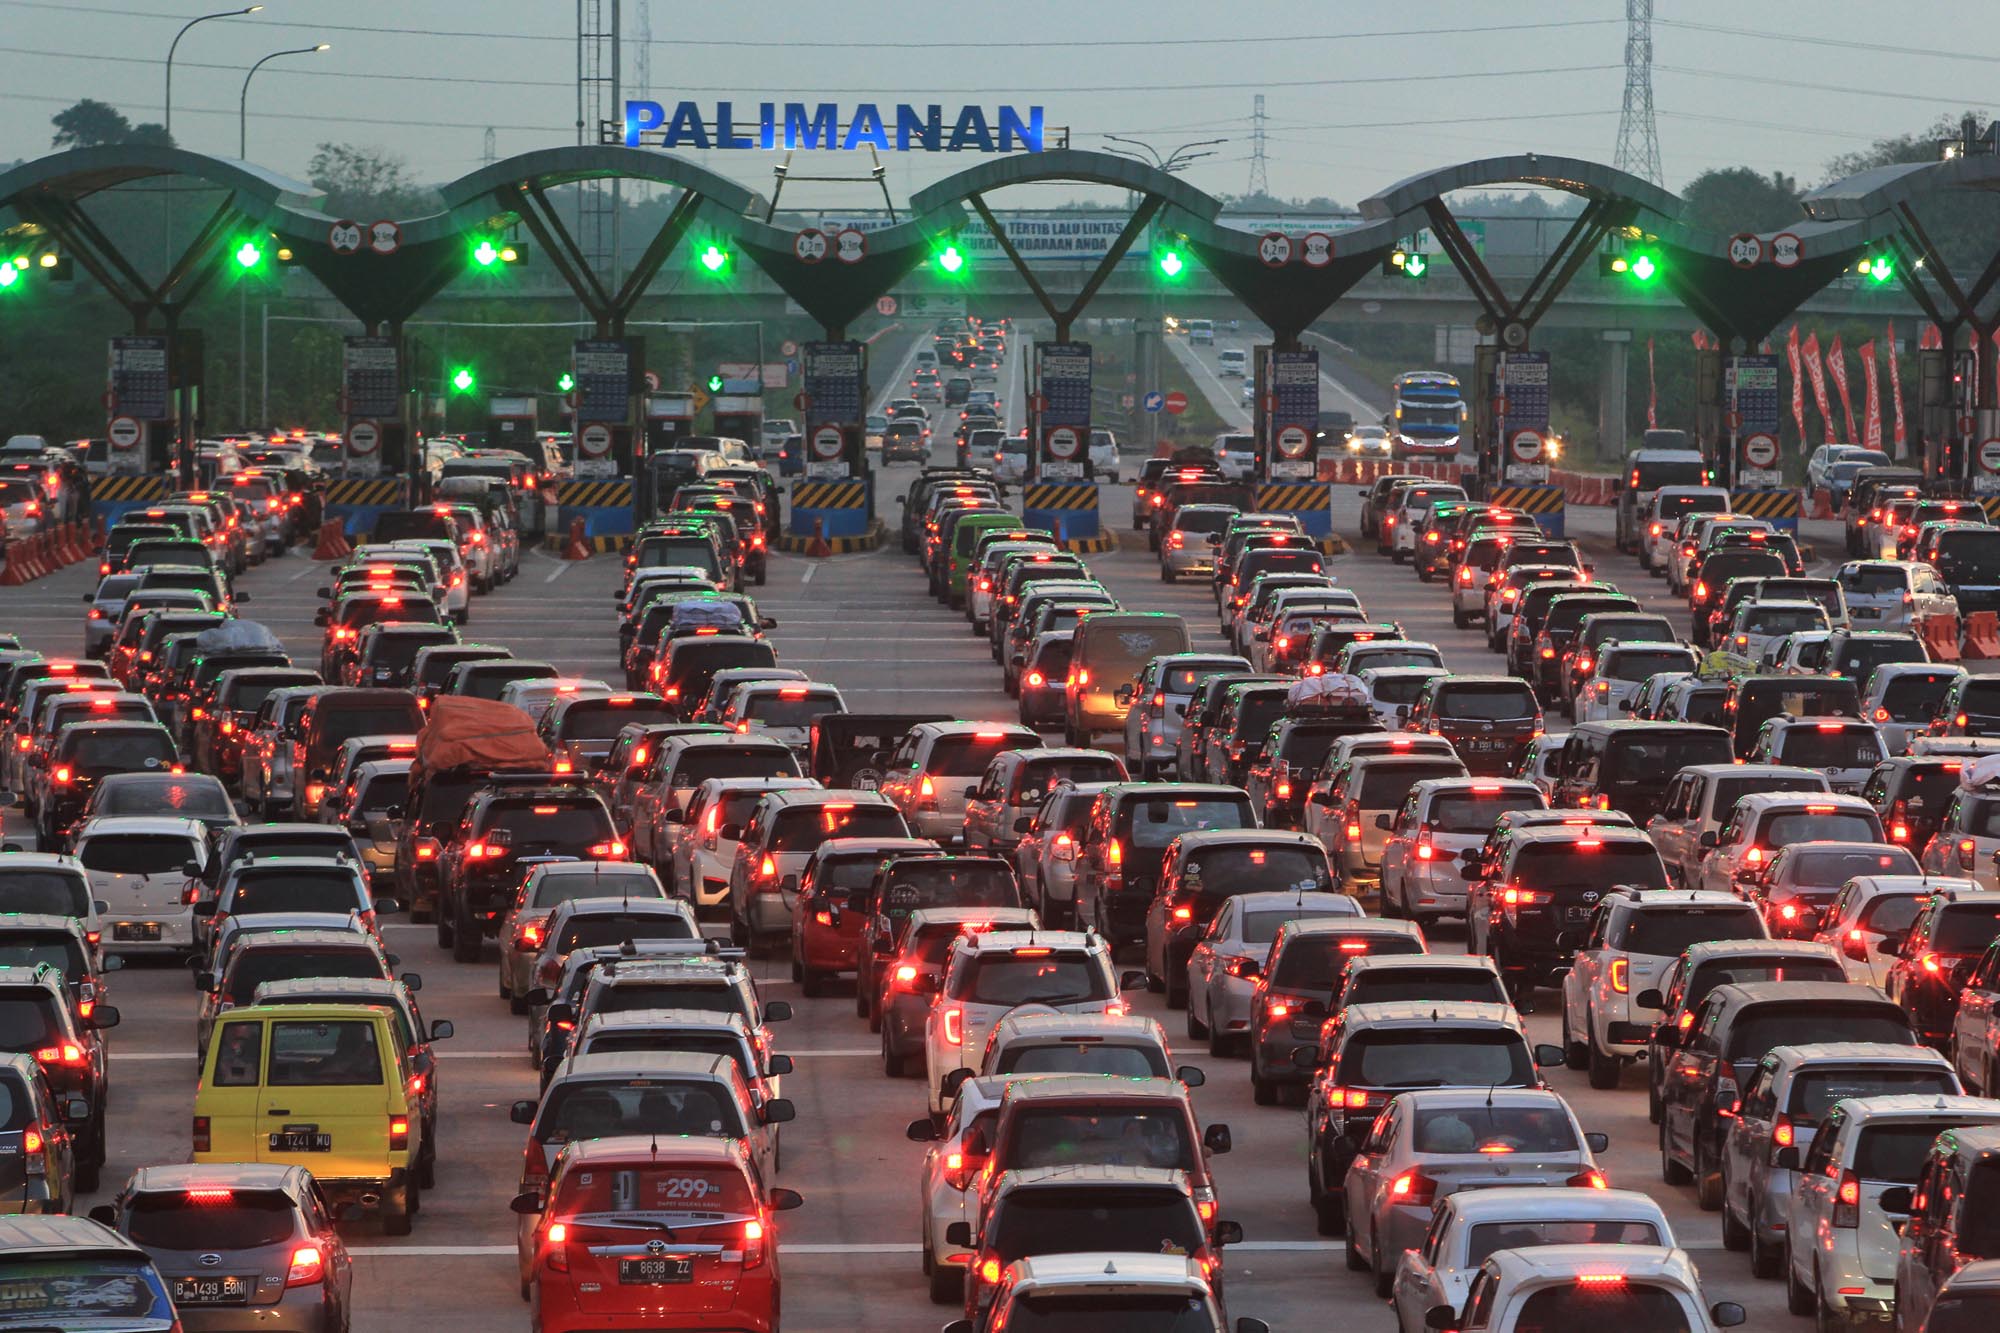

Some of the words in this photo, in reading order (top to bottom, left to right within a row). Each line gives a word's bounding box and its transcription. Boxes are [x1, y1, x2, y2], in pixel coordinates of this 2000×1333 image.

[624, 100, 1044, 153] PALIMANAN
[1009, 222, 1050, 235] TERTIB
[1052, 222, 1080, 235] LALU
[1083, 222, 1123, 234] LINTAS
[1008, 238, 1073, 250] ENDARAAN
[1075, 238, 1108, 250] ANDA
[666, 1178, 709, 1198] 299
[622, 1261, 629, 1274] H
[640, 1261, 665, 1274] 8638
[677, 1261, 689, 1274] ZZ
[177, 1283, 184, 1295] B
[193, 1282, 218, 1295] 1439
